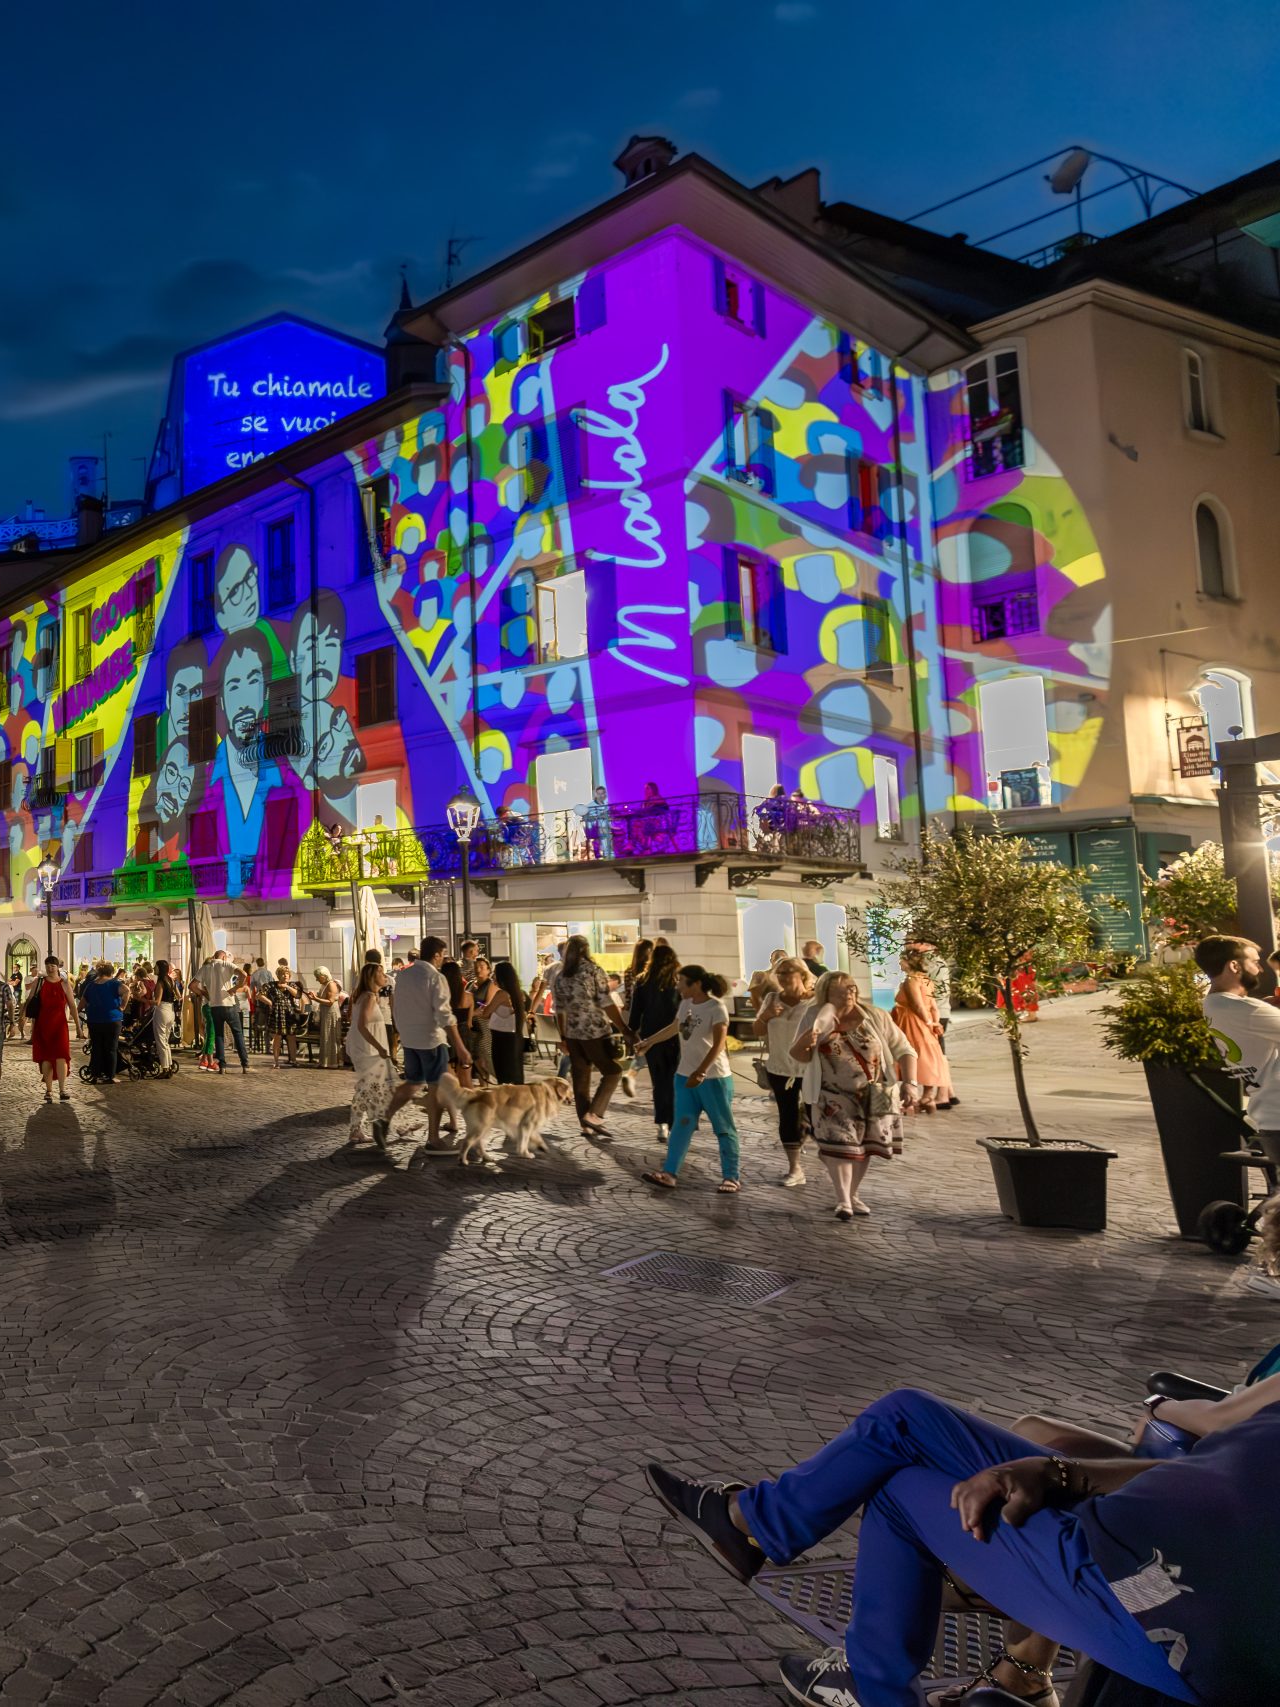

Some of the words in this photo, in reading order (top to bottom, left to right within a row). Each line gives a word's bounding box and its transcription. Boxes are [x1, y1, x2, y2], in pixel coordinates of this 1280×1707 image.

[207, 373, 241, 397] Tu
[253, 373, 373, 398] chiamale
[241, 416, 269, 432] se
[281, 411, 336, 432] vuoi
[569, 343, 668, 568] Lodola
